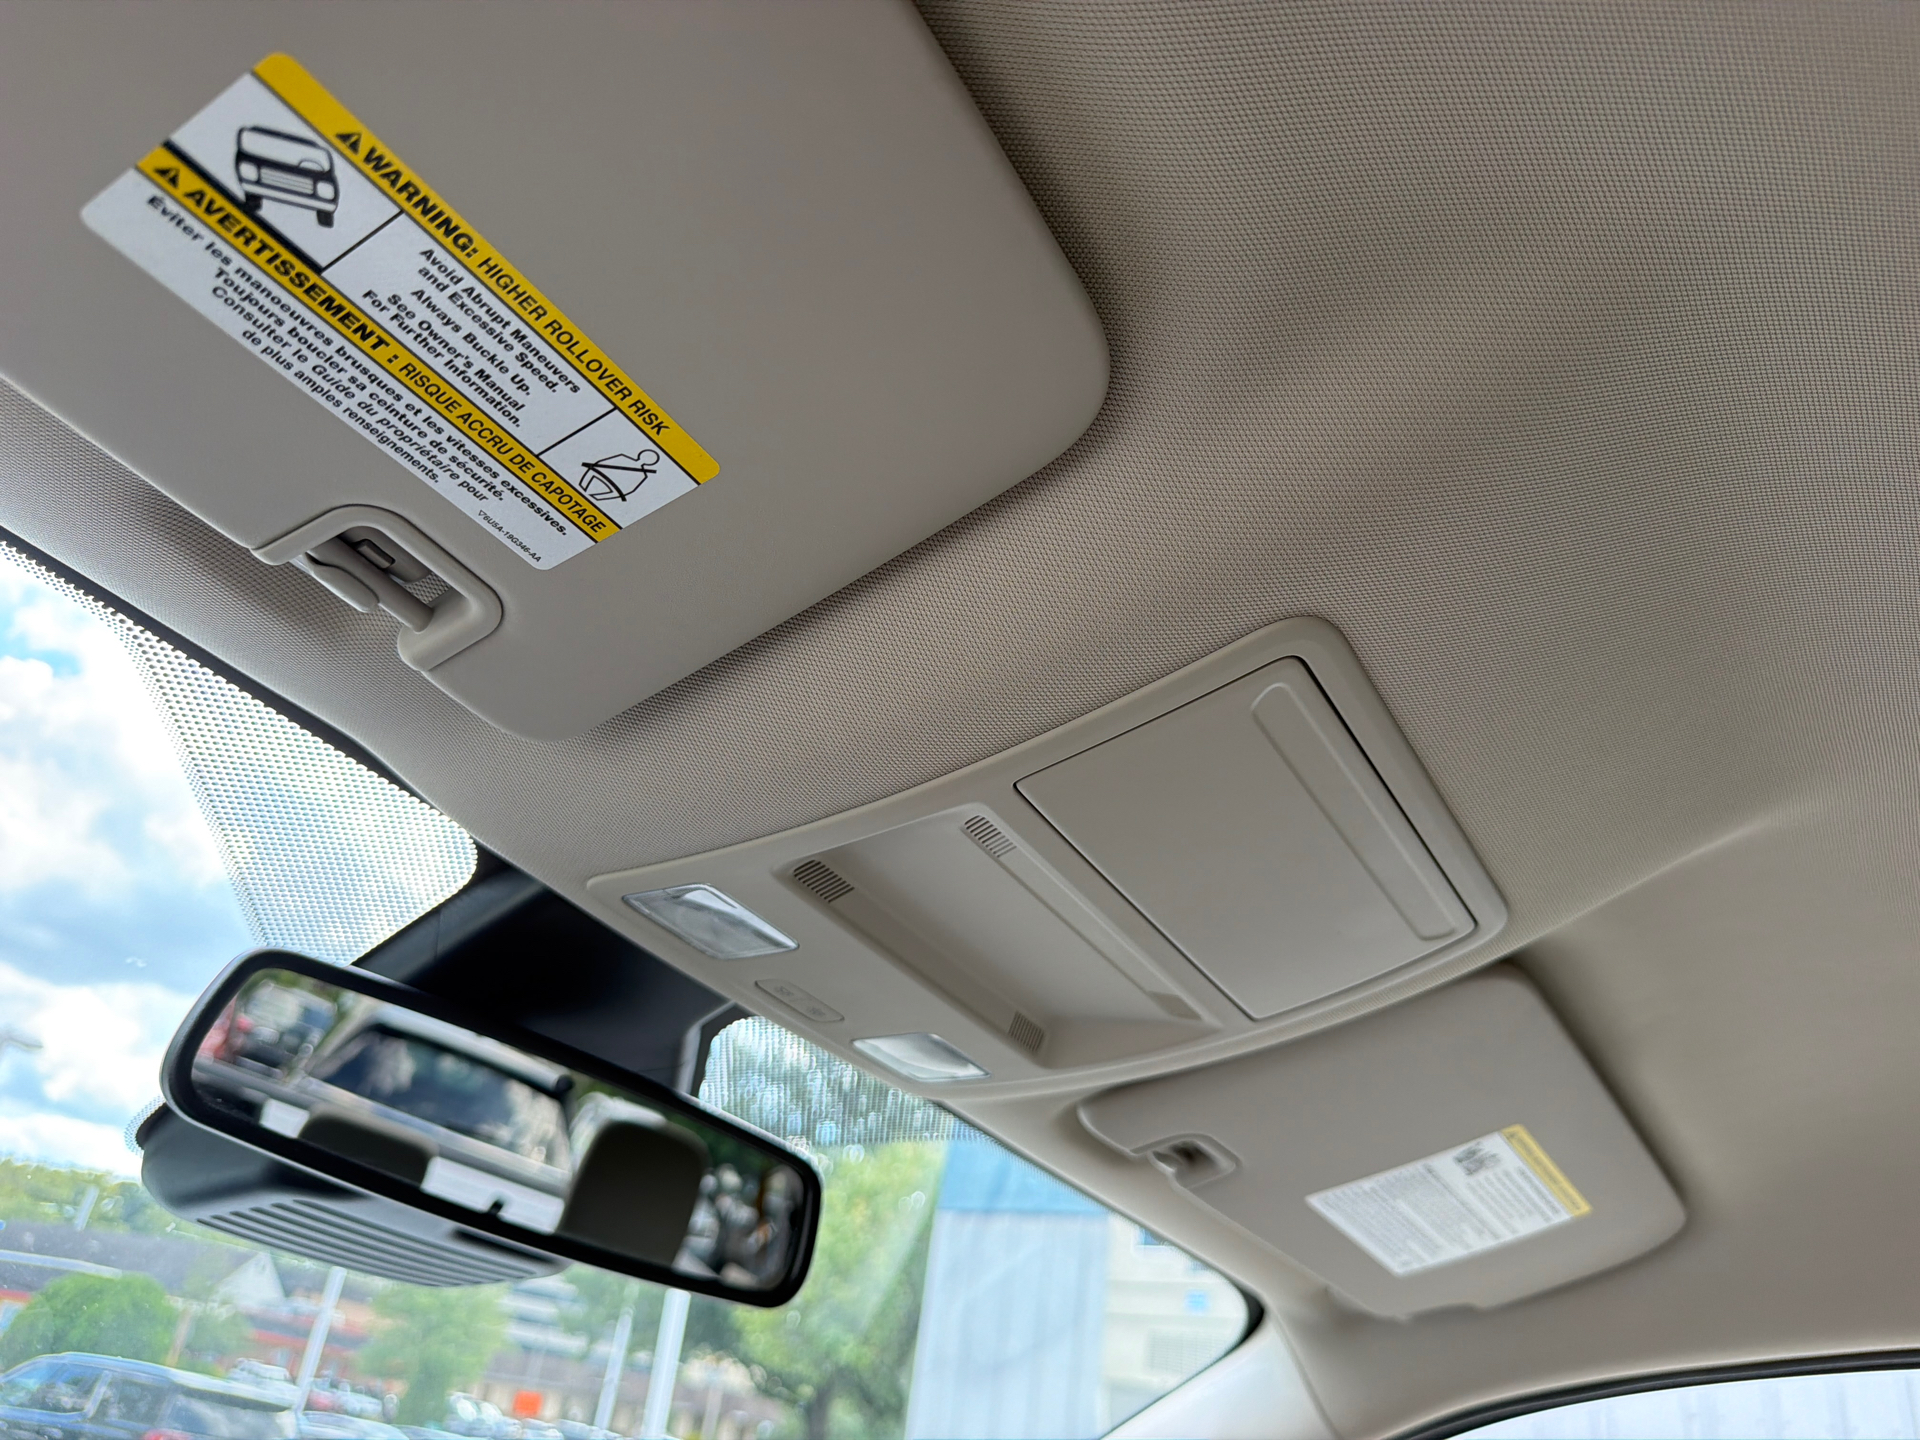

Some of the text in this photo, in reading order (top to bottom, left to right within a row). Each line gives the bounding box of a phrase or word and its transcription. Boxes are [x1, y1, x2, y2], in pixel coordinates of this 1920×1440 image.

[183, 189, 391, 351] AVERTISSEMENT
[398, 361, 463, 414] RISQUE
[455, 411, 514, 455] ACCRU
[507, 452, 536, 474] DE
[530, 471, 607, 533] CAPOTAGE
[361, 289, 520, 428] For Further Information.
[362, 146, 670, 436] WARNING: HIGHER ROLLOVER RISK
[386, 293, 526, 412] See Owner's Manual
[410, 289, 530, 396] Always Buckle Up.
[417, 266, 559, 393] and Excessive Speed.
[419, 248, 581, 394] Avoid Abrupt Maneuvers
[204, 241, 232, 266] les
[234, 266, 334, 347] manoeuvres
[334, 345, 404, 406] brusques
[404, 402, 423, 417] et
[421, 414, 445, 435] les
[445, 434, 500, 479] vitesses
[500, 479, 567, 536] excessives.
[211, 285, 489, 501] Consulter le Guide du propriétaire pour
[214, 266, 505, 501] Toujours boucler sa ceinture de sécurité.
[241, 329, 439, 484] de plus amples renseignements.
